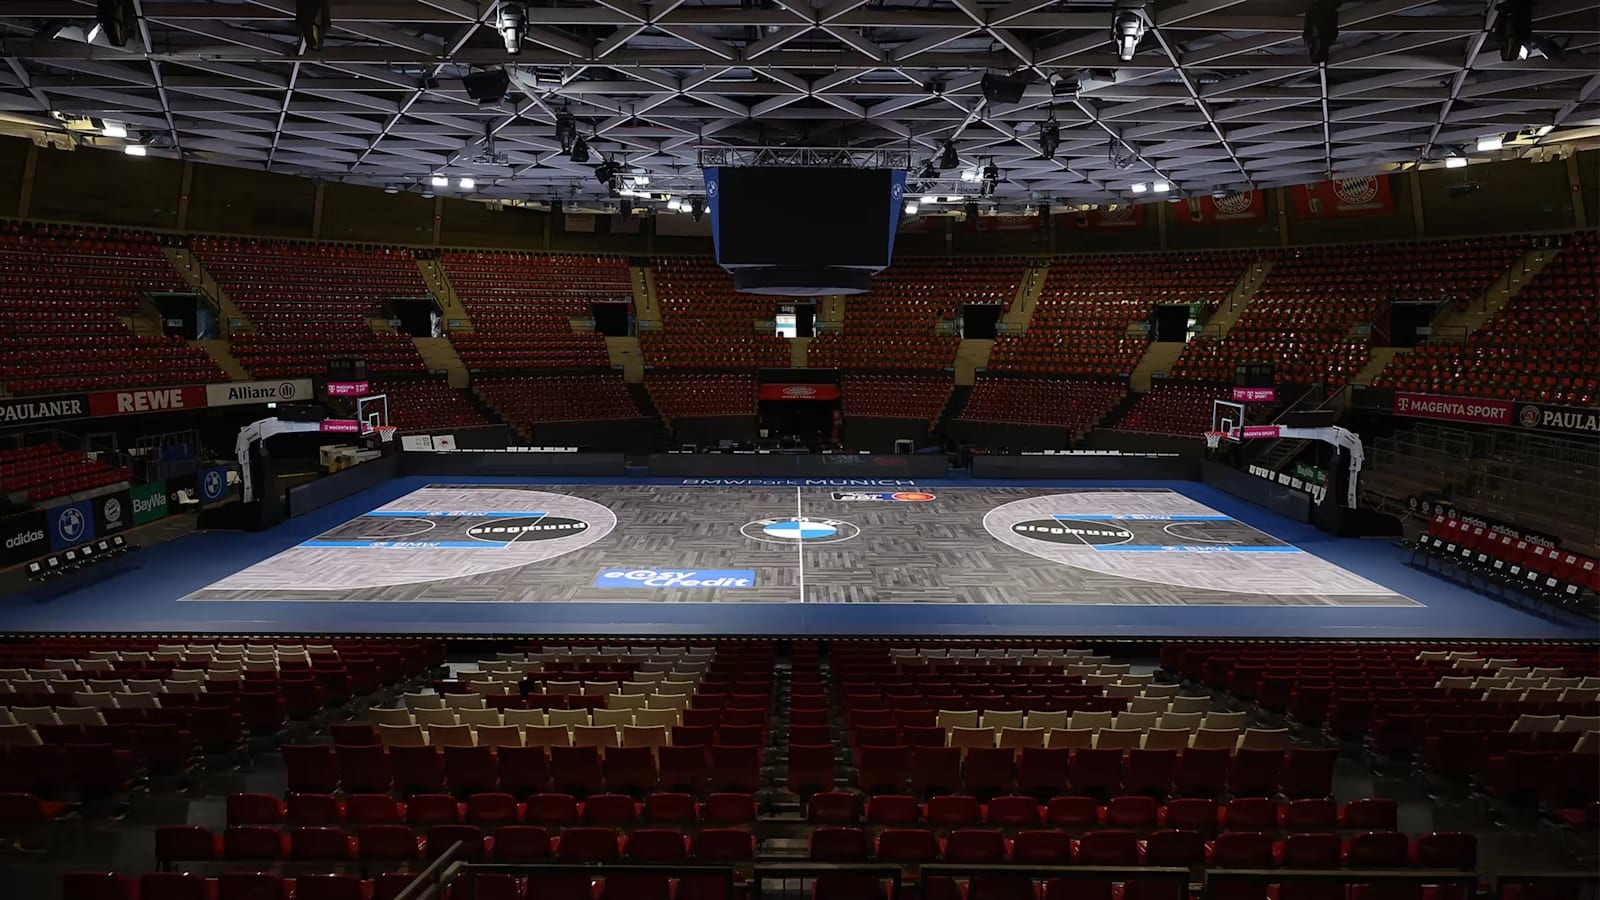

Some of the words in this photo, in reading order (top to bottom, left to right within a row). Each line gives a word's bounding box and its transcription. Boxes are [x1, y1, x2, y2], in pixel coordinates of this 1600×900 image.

[116, 389, 184, 413] REWE
[228, 387, 276, 400] Allianz
[1411, 401, 1464, 415] MAGENTA
[1466, 406, 1507, 420] SPORT
[132, 493, 167, 513] BayWa
[1461, 515, 1487, 530] adidas
[5, 529, 45, 549] adidas
[1492, 524, 1519, 539] adidas
[1524, 533, 1555, 549] adidas
[643, 577, 749, 587] Credit
